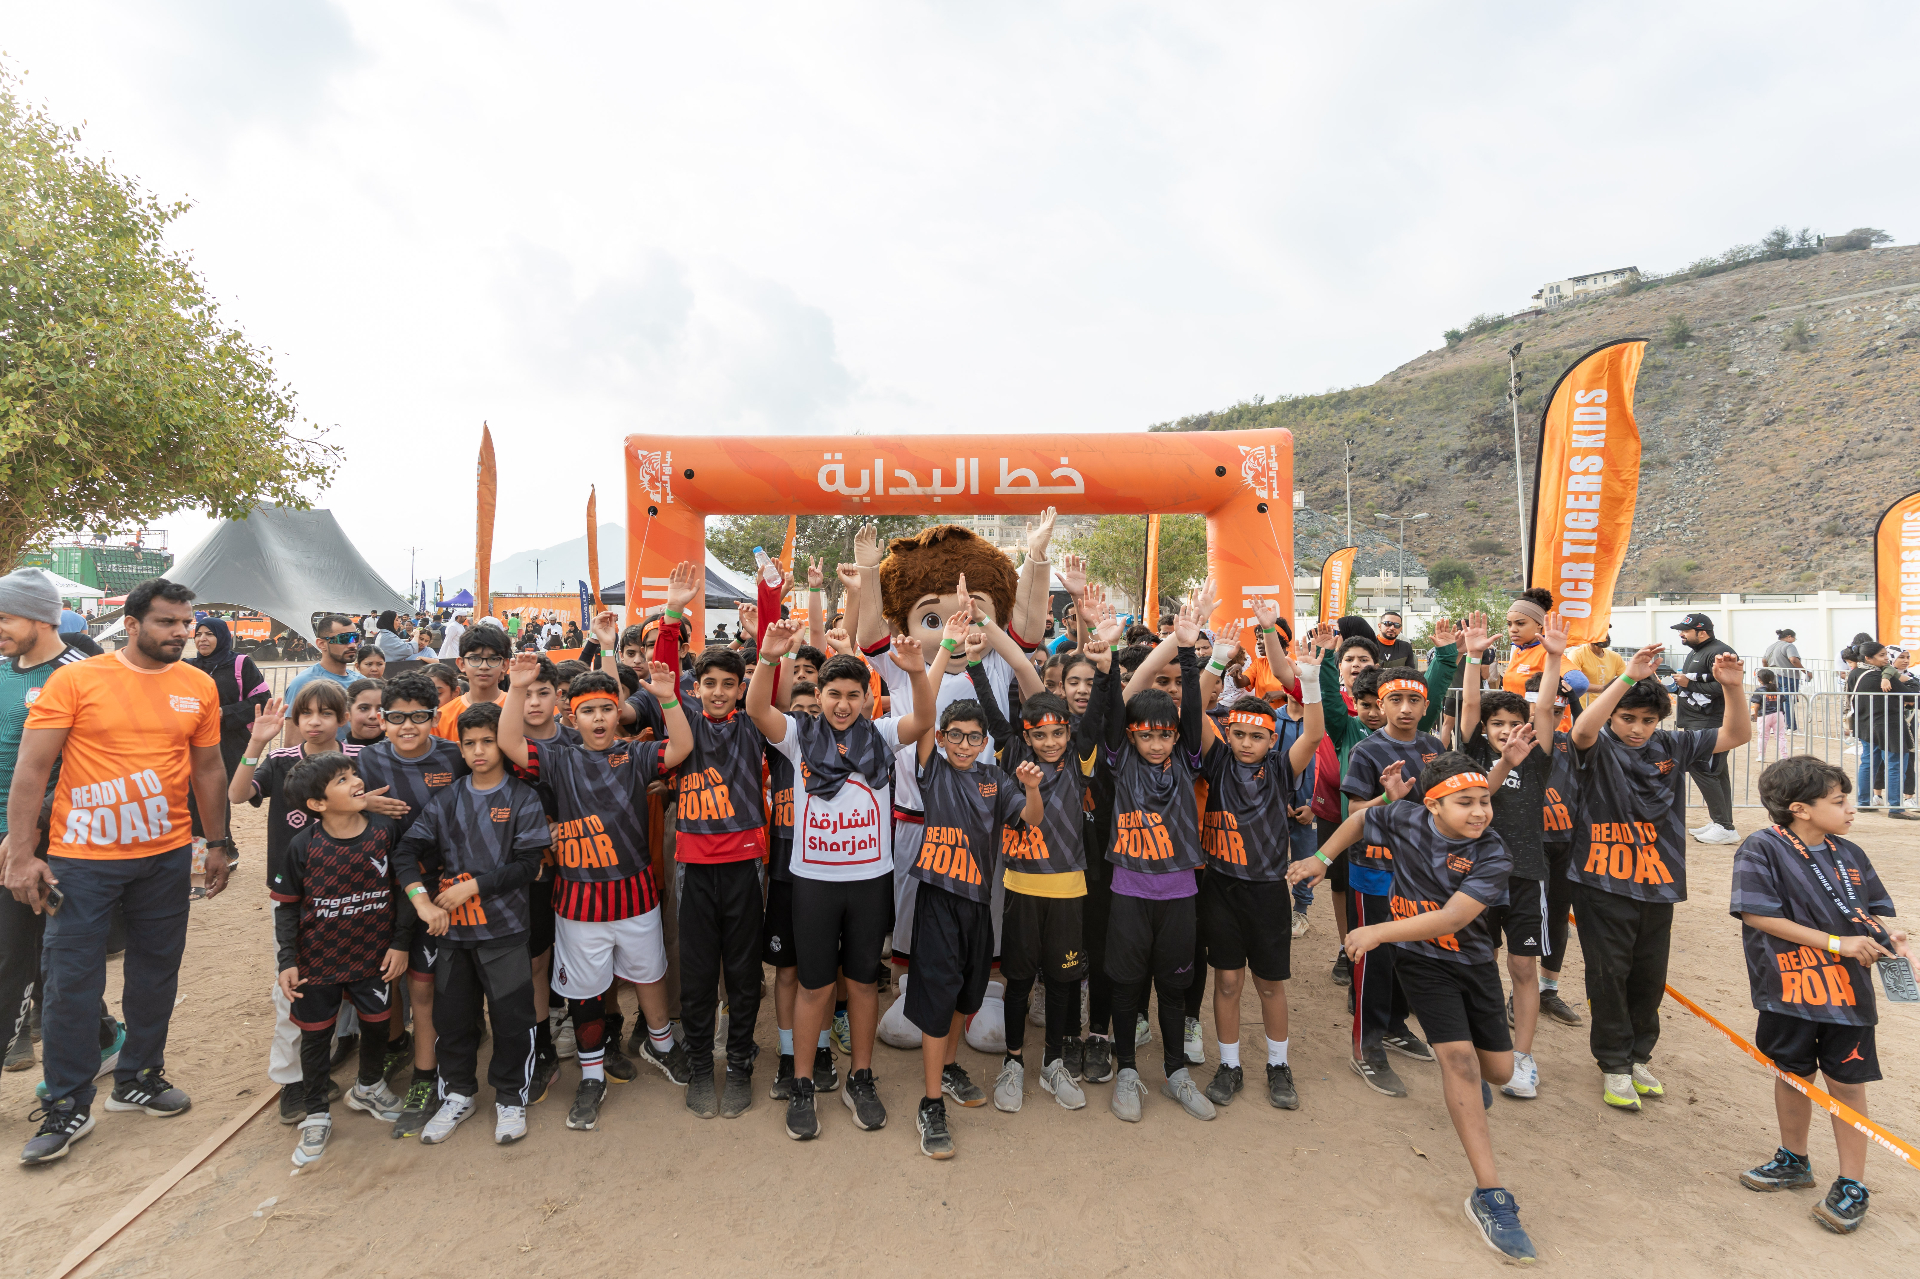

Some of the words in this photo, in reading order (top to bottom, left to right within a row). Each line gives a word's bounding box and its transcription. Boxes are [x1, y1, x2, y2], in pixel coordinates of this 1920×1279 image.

[1571, 388, 1609, 448] KIDS
[817, 452, 980, 503] البداية
[994, 456, 1085, 495] خط
[1562, 455, 1604, 558] TIGERS
[1559, 563, 1595, 618] OCR
[1900, 546, 1920, 612] TIGERS
[1900, 614, 1920, 651] OCR
[1400, 680, 1424, 693] 1144
[1237, 713, 1263, 726] 1170
[71, 777, 128, 808] READY
[130, 769, 162, 798] TO
[680, 772, 705, 792] READY
[704, 767, 723, 786] TO
[677, 785, 735, 820] ROAR
[775, 787, 794, 805] READ
[63, 795, 172, 845] ROAR
[558, 818, 584, 840] EADY
[583, 814, 605, 835] TO
[810, 809, 875, 834] الشارقة
[1117, 810, 1144, 828] READY
[1144, 812, 1163, 827] TO
[1222, 810, 1238, 830] TO
[1543, 803, 1573, 831] AR
[808, 834, 877, 856] Sharjah
[926, 827, 962, 847] READY
[1113, 825, 1175, 861] ROAR
[1202, 826, 1248, 866] ROAR
[1634, 822, 1658, 843] TO
[1584, 842, 1675, 884] ROAR
[1810, 863, 1832, 891] FINISHER
[313, 890, 390, 908] Together
[316, 909, 339, 918] We
[342, 902, 388, 915] Grow
[448, 894, 488, 926] AR
[1780, 964, 1857, 1006] ROAR
[1873, 1132, 1910, 1162] TIGERS
